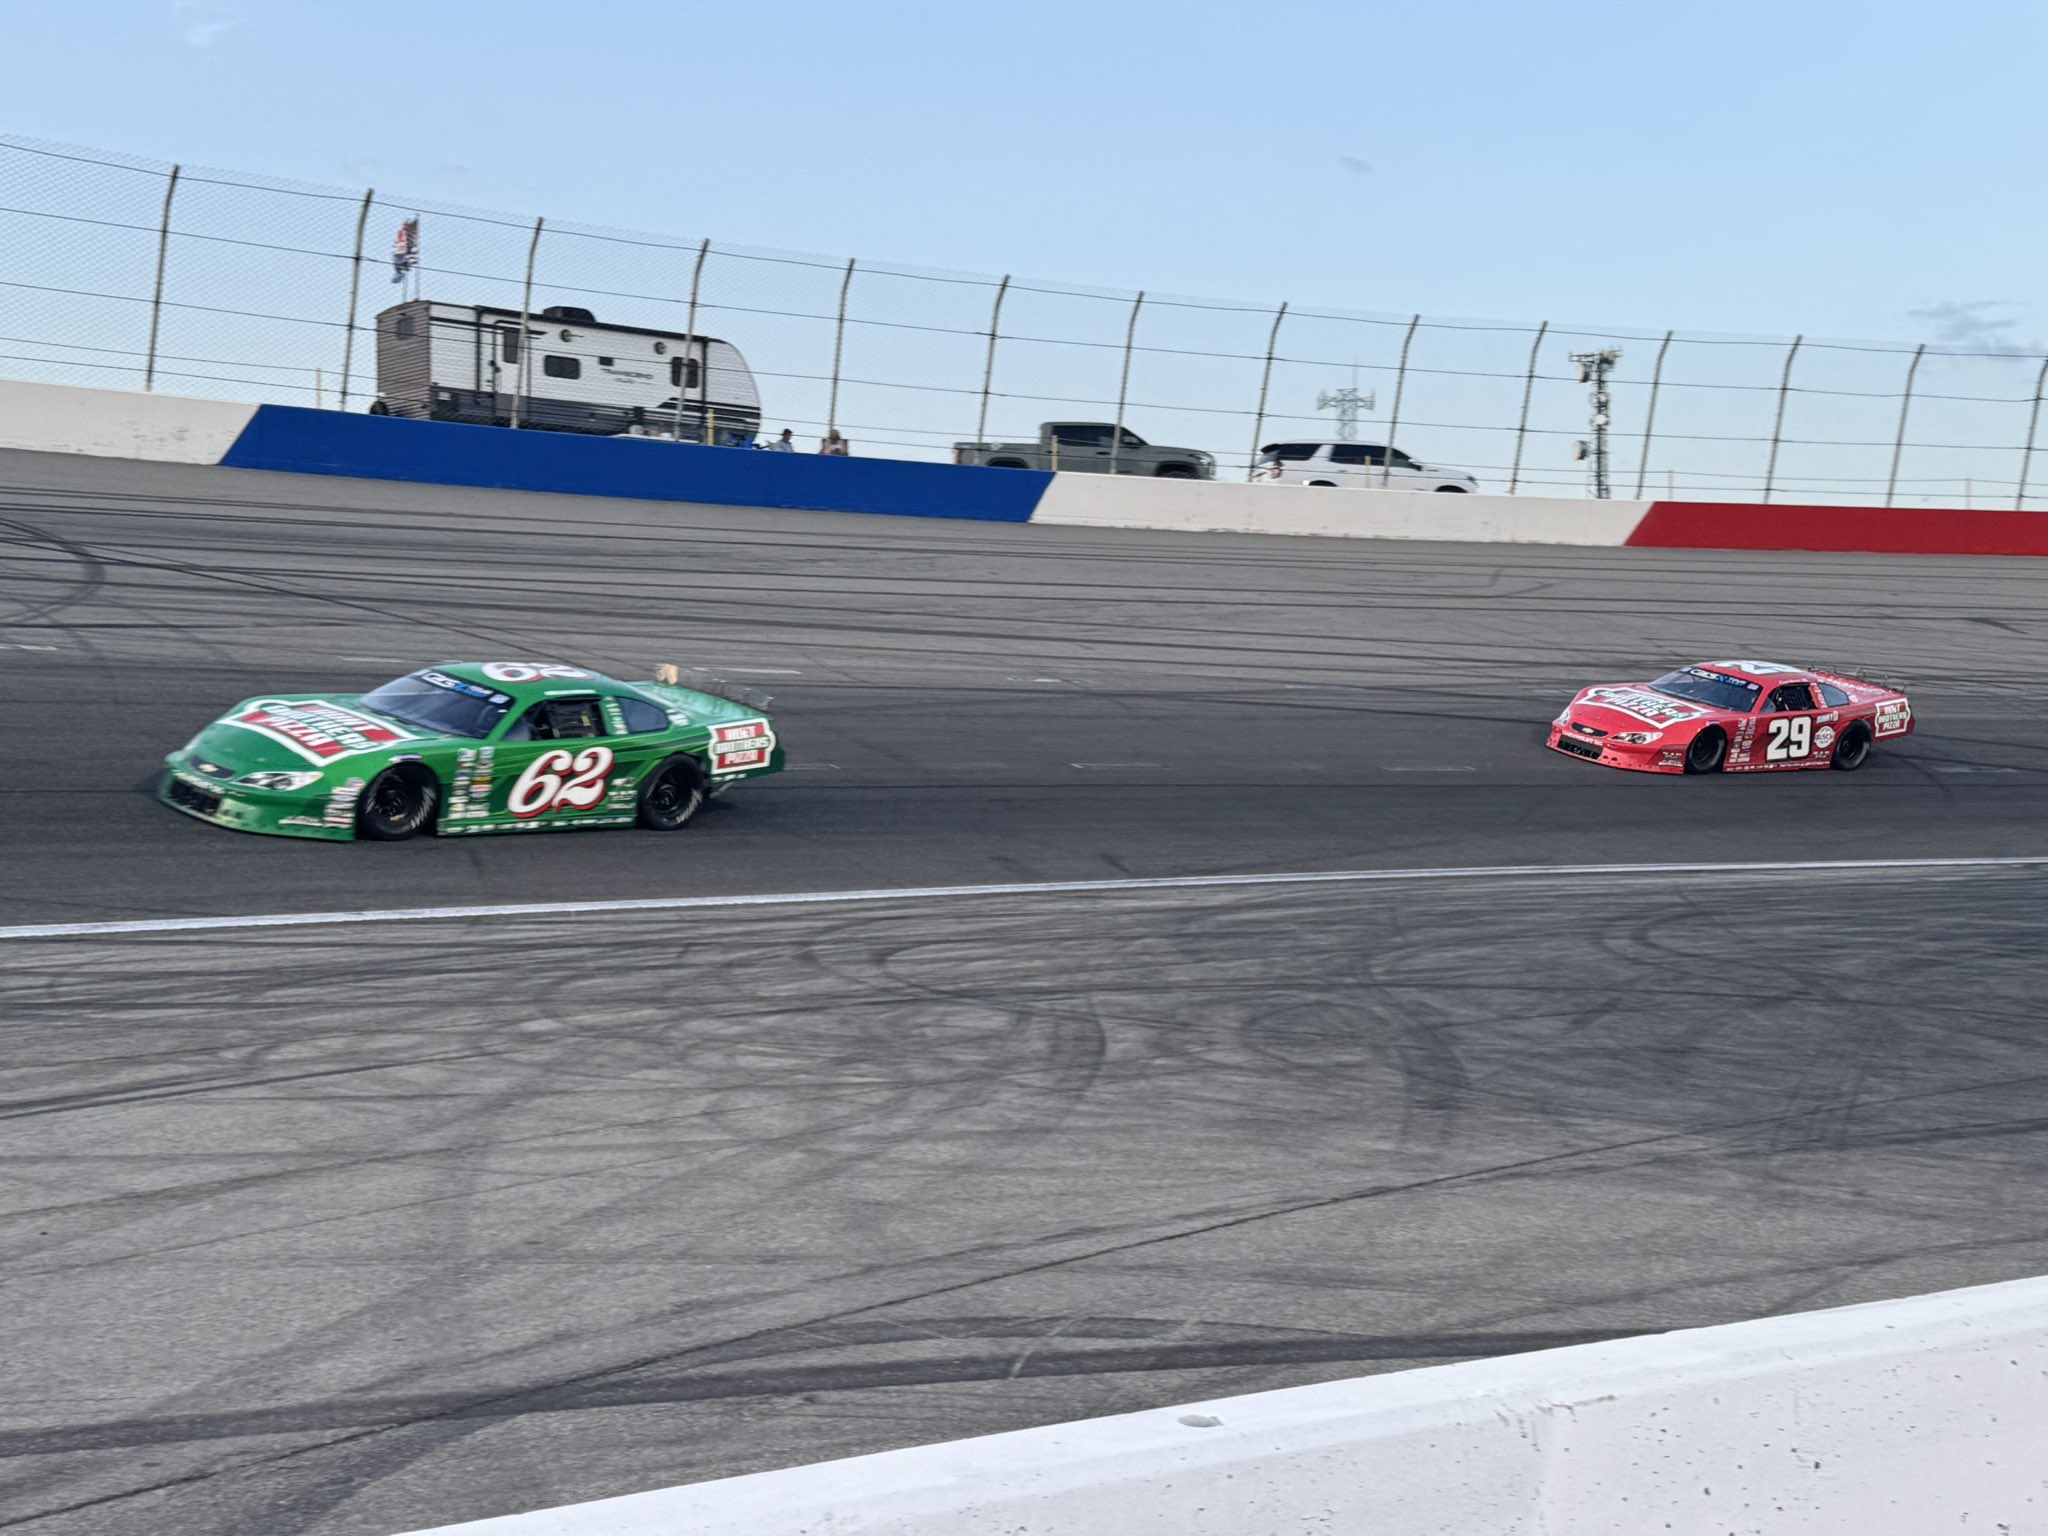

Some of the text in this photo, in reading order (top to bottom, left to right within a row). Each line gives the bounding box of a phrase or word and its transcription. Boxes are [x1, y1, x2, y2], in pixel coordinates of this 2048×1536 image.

[256, 716, 332, 747] PIZZA
[1766, 715, 1812, 762] 29
[507, 746, 615, 819] 62
